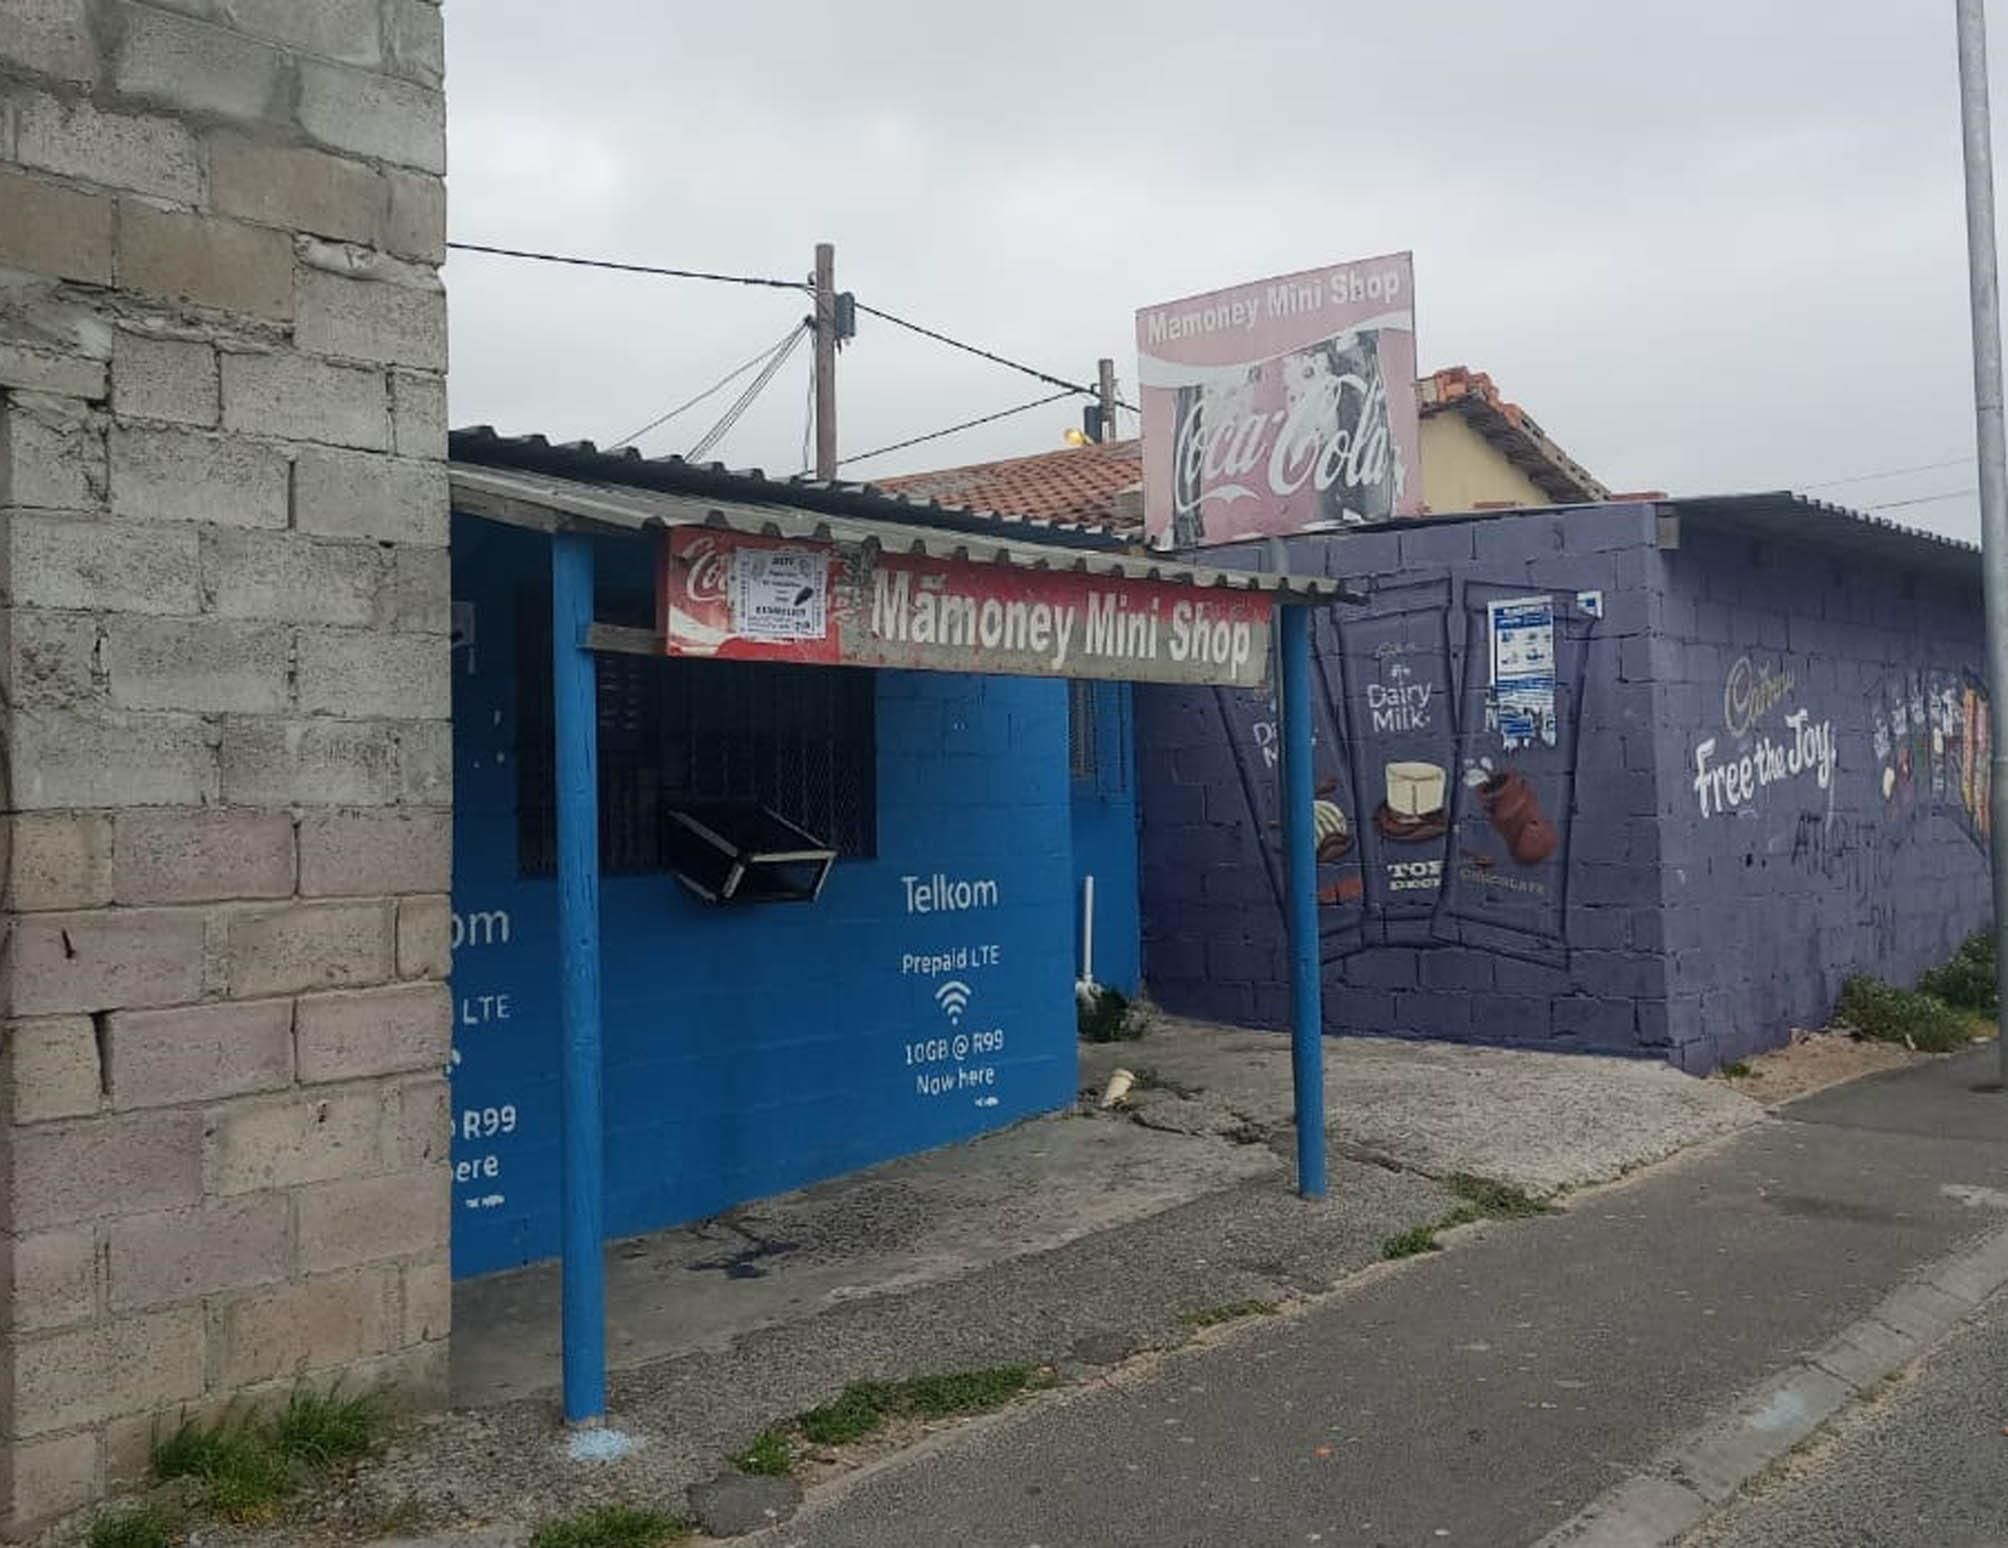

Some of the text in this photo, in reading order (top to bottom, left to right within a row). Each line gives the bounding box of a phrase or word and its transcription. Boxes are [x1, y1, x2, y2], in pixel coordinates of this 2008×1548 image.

[1147, 268, 1399, 345] Mamoney Mini Shop
[1085, 590, 1160, 659] Mini
[1169, 600, 1250, 680] Shop
[1367, 682, 1432, 709] Dairy
[1372, 704, 1425, 733] Milk
[1694, 738, 1754, 818] Free
[1753, 737, 1787, 786] the
[901, 874, 998, 913] Telkom
[902, 945, 1000, 977] Prepaid LTE
[463, 995, 511, 1024] LTE
[905, 1029, 1003, 1065] 10GB @ R99
[916, 1067, 994, 1096] Now here
[463, 1105, 516, 1140] R99
